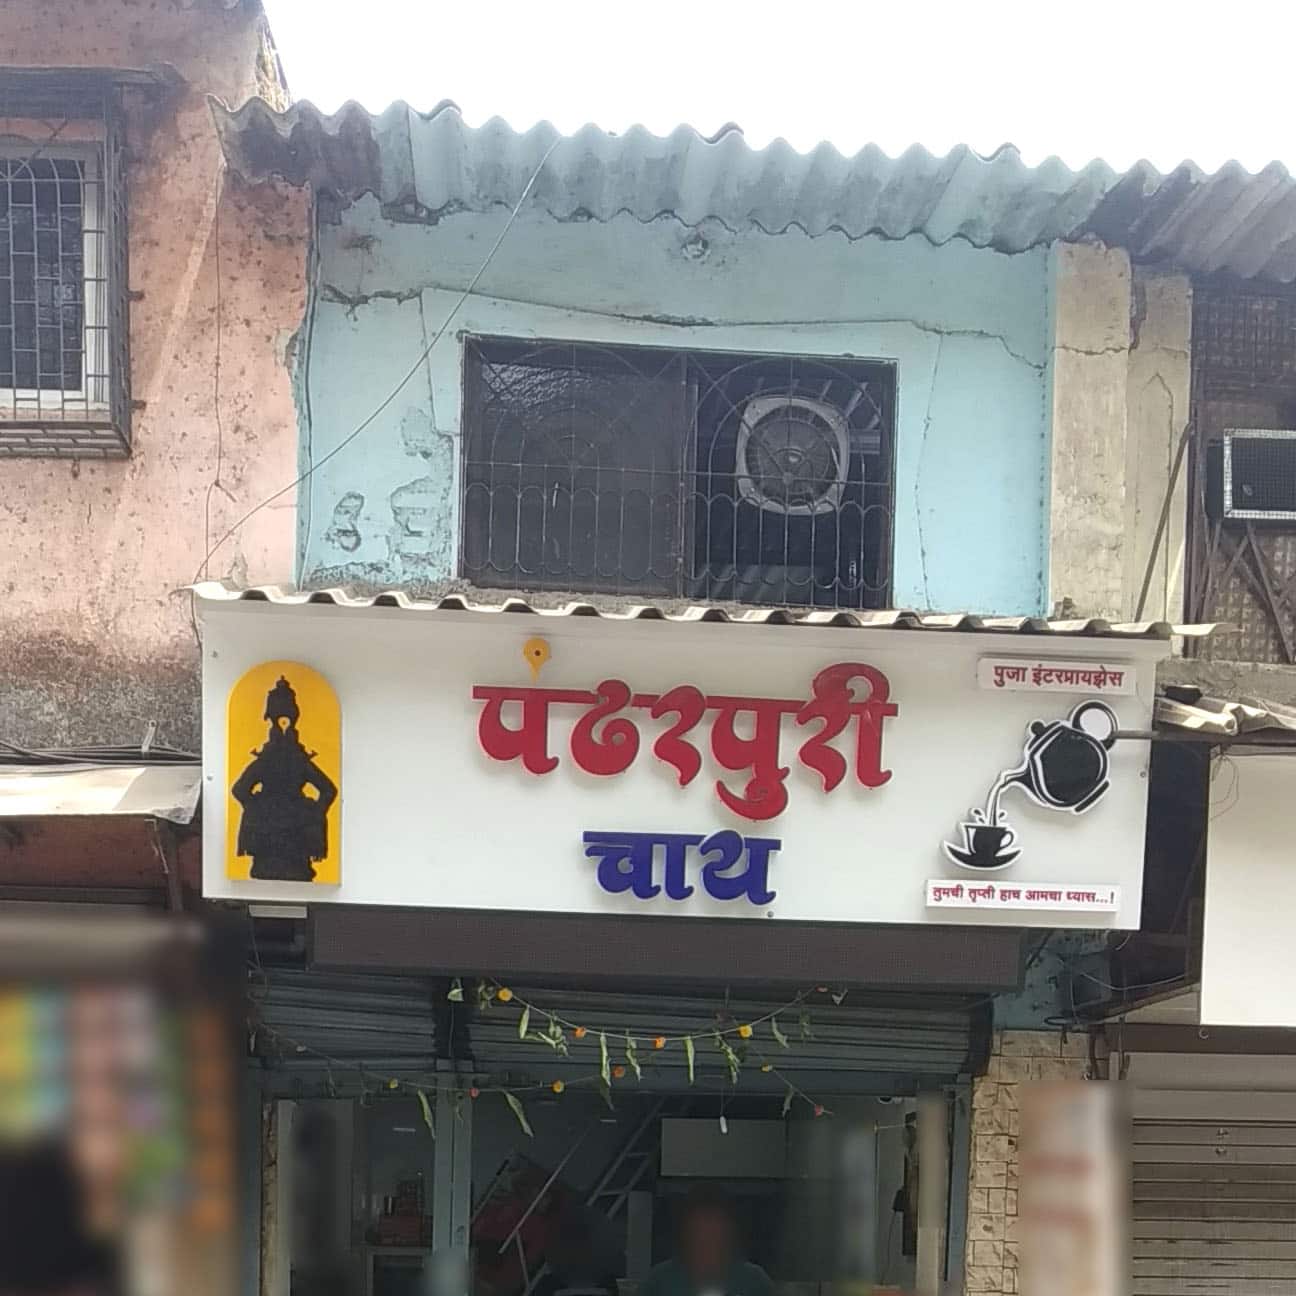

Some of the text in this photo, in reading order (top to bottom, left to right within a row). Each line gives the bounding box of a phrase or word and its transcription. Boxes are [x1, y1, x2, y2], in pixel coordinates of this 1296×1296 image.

[994, 665, 1028, 687] पुजा
[472, 637, 899, 821] पंढरपुरी
[582, 829, 782, 906] चाय
[932, 883, 964, 902] तुमची
[1024, 889, 1063, 902] आमचा
